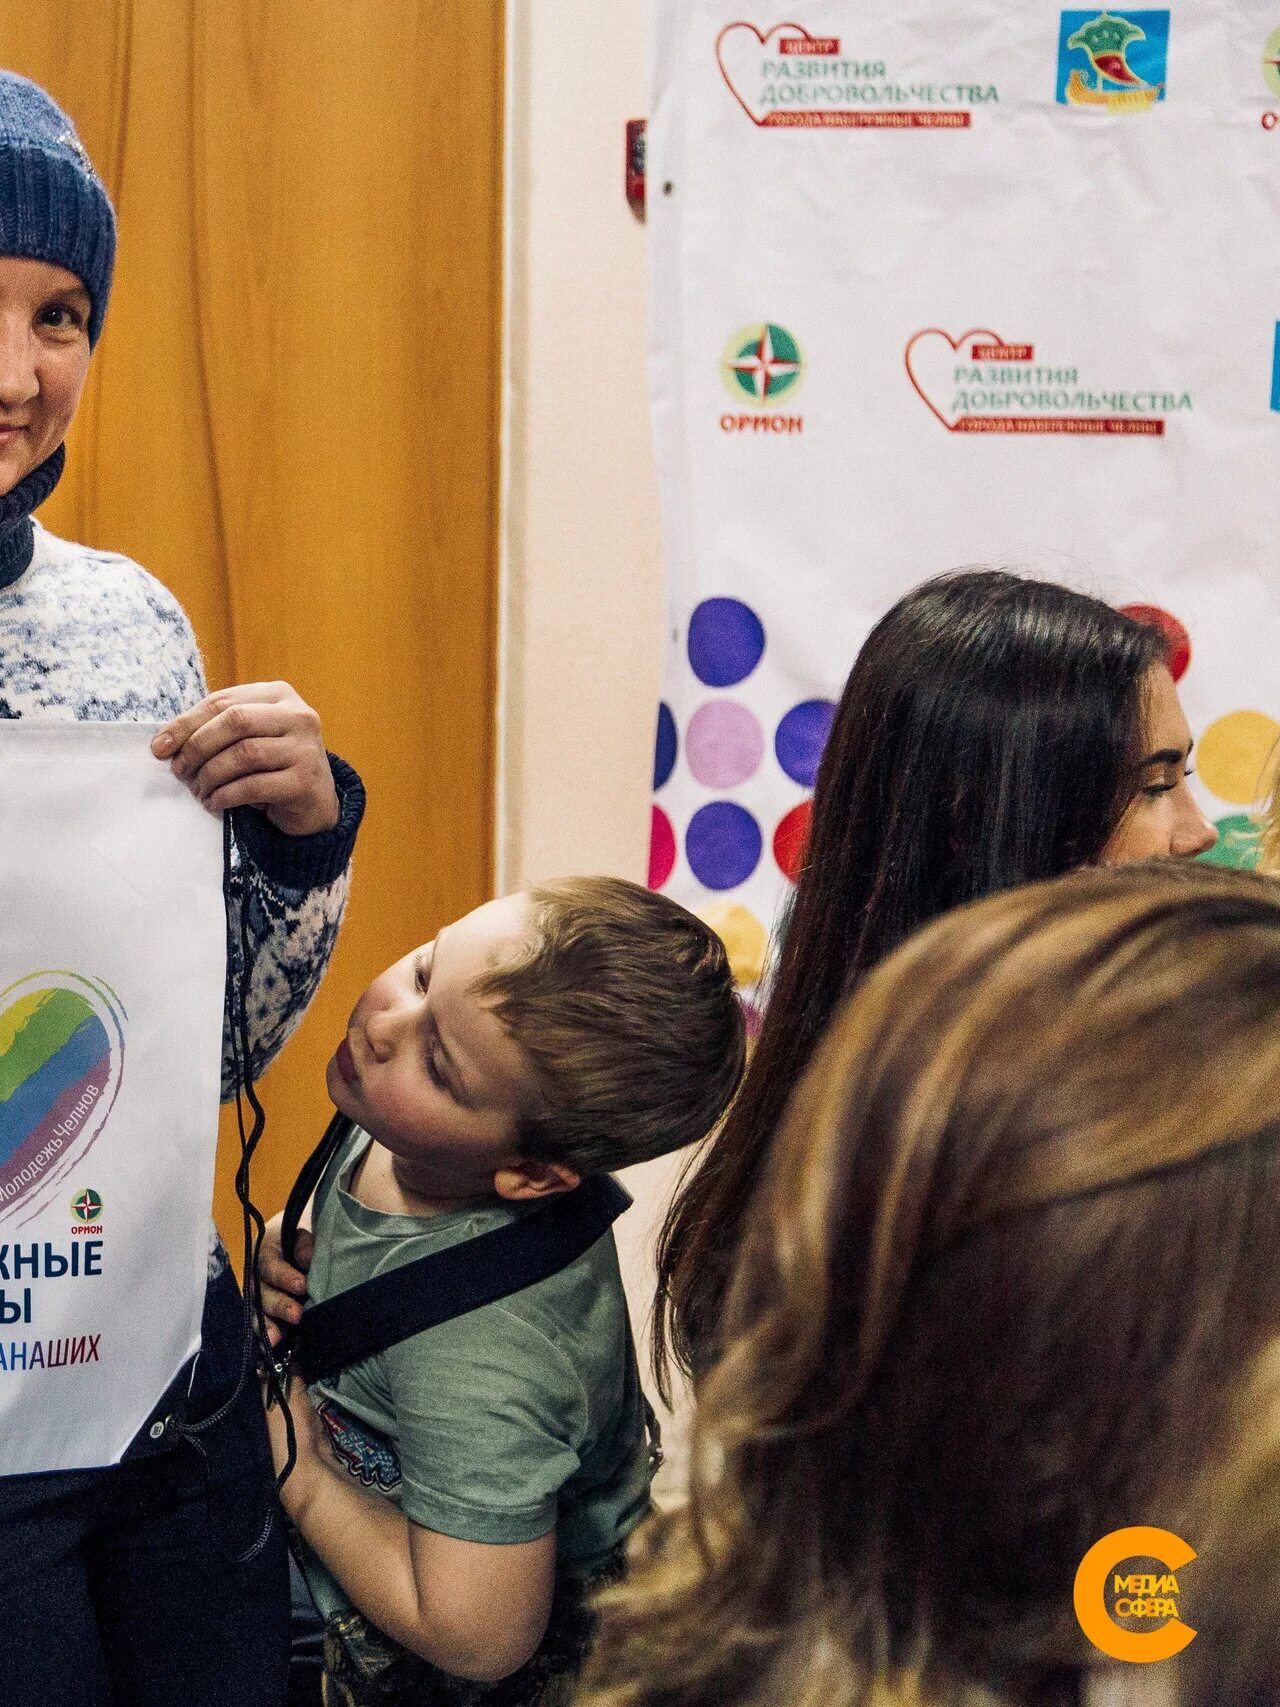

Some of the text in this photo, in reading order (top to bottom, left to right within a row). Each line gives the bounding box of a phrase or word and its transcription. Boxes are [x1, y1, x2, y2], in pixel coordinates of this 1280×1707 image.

[785, 41, 834, 53] ЦЕНТР
[762, 59, 886, 79] РАЗВИТИЯ
[760, 83, 1000, 106] ДОБРОВОЛЬЧЕСТВА
[977, 346, 1026, 359] ЦЕНТР
[953, 366, 1079, 385] РАЗВИТИЯ
[952, 389, 1193, 412] ДОБРОВОЛЬЧЕСТВА
[719, 414, 803, 433] ОРИОН
[71, 1225, 103, 1235] ОРИОН
